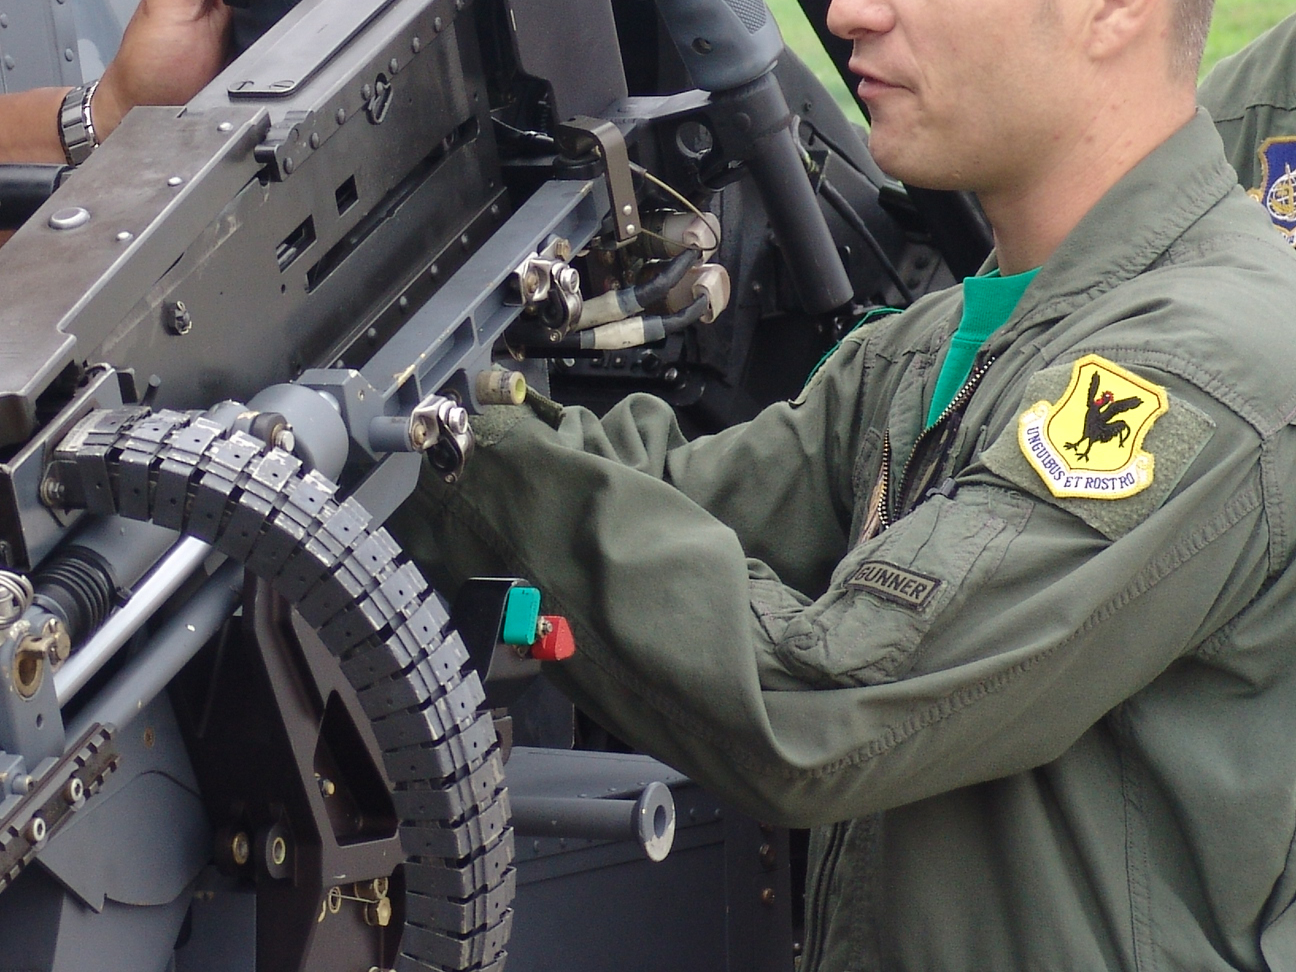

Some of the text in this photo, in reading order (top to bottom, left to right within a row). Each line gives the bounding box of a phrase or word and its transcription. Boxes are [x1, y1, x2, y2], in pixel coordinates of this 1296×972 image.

[1027, 426, 1135, 491] UNGUIBUS ET ROSTRO
[854, 567, 928, 600] GUNNER
